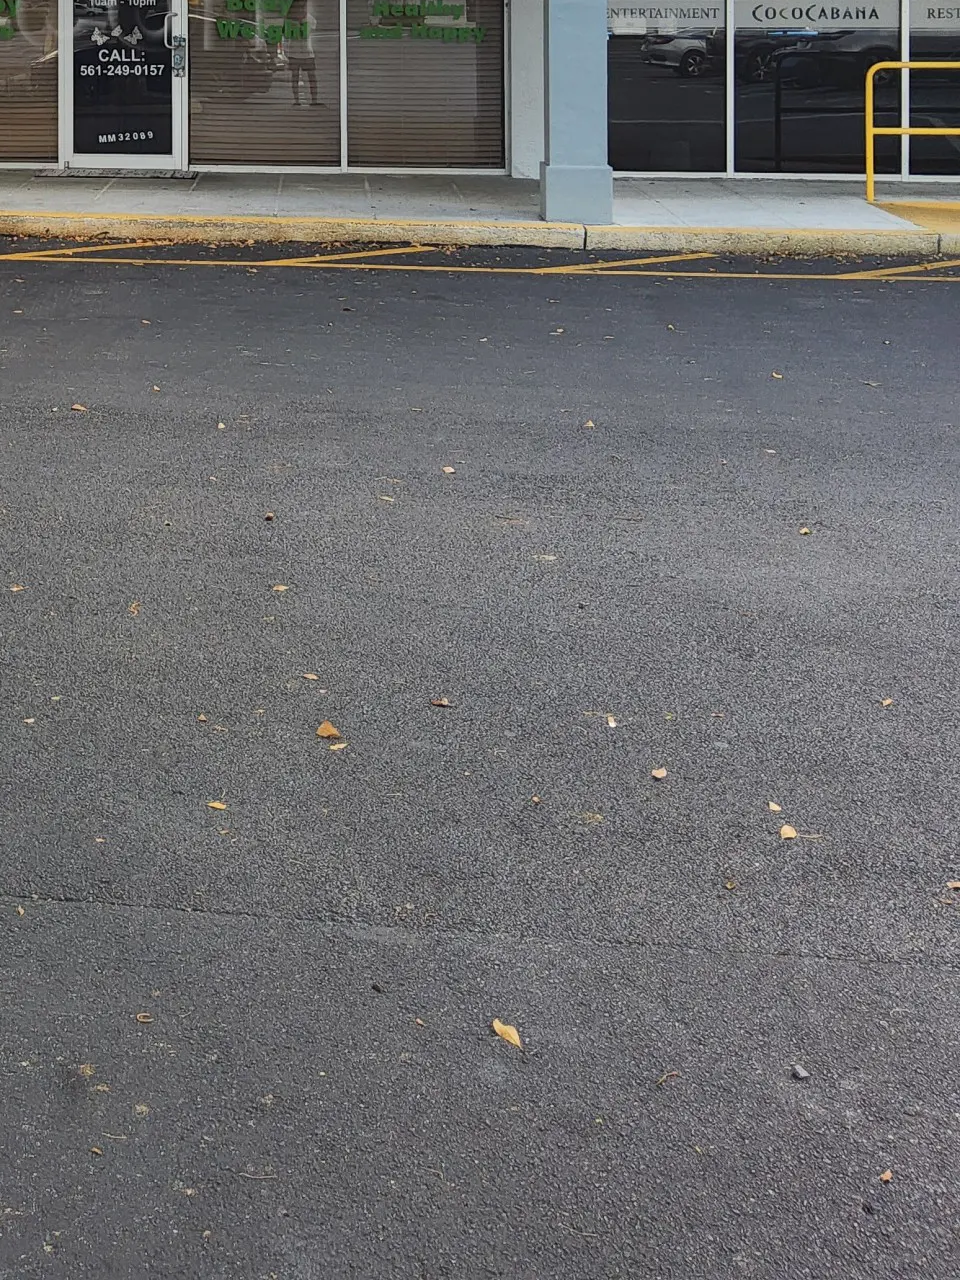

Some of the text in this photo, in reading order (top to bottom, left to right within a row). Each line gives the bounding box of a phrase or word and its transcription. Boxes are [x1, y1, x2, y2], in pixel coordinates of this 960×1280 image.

[216, 17, 310, 45] Weight
[410, 23, 488, 44] Happy
[98, 49, 146, 62] CALL:
[80, 64, 165, 76] 561-249-0157
